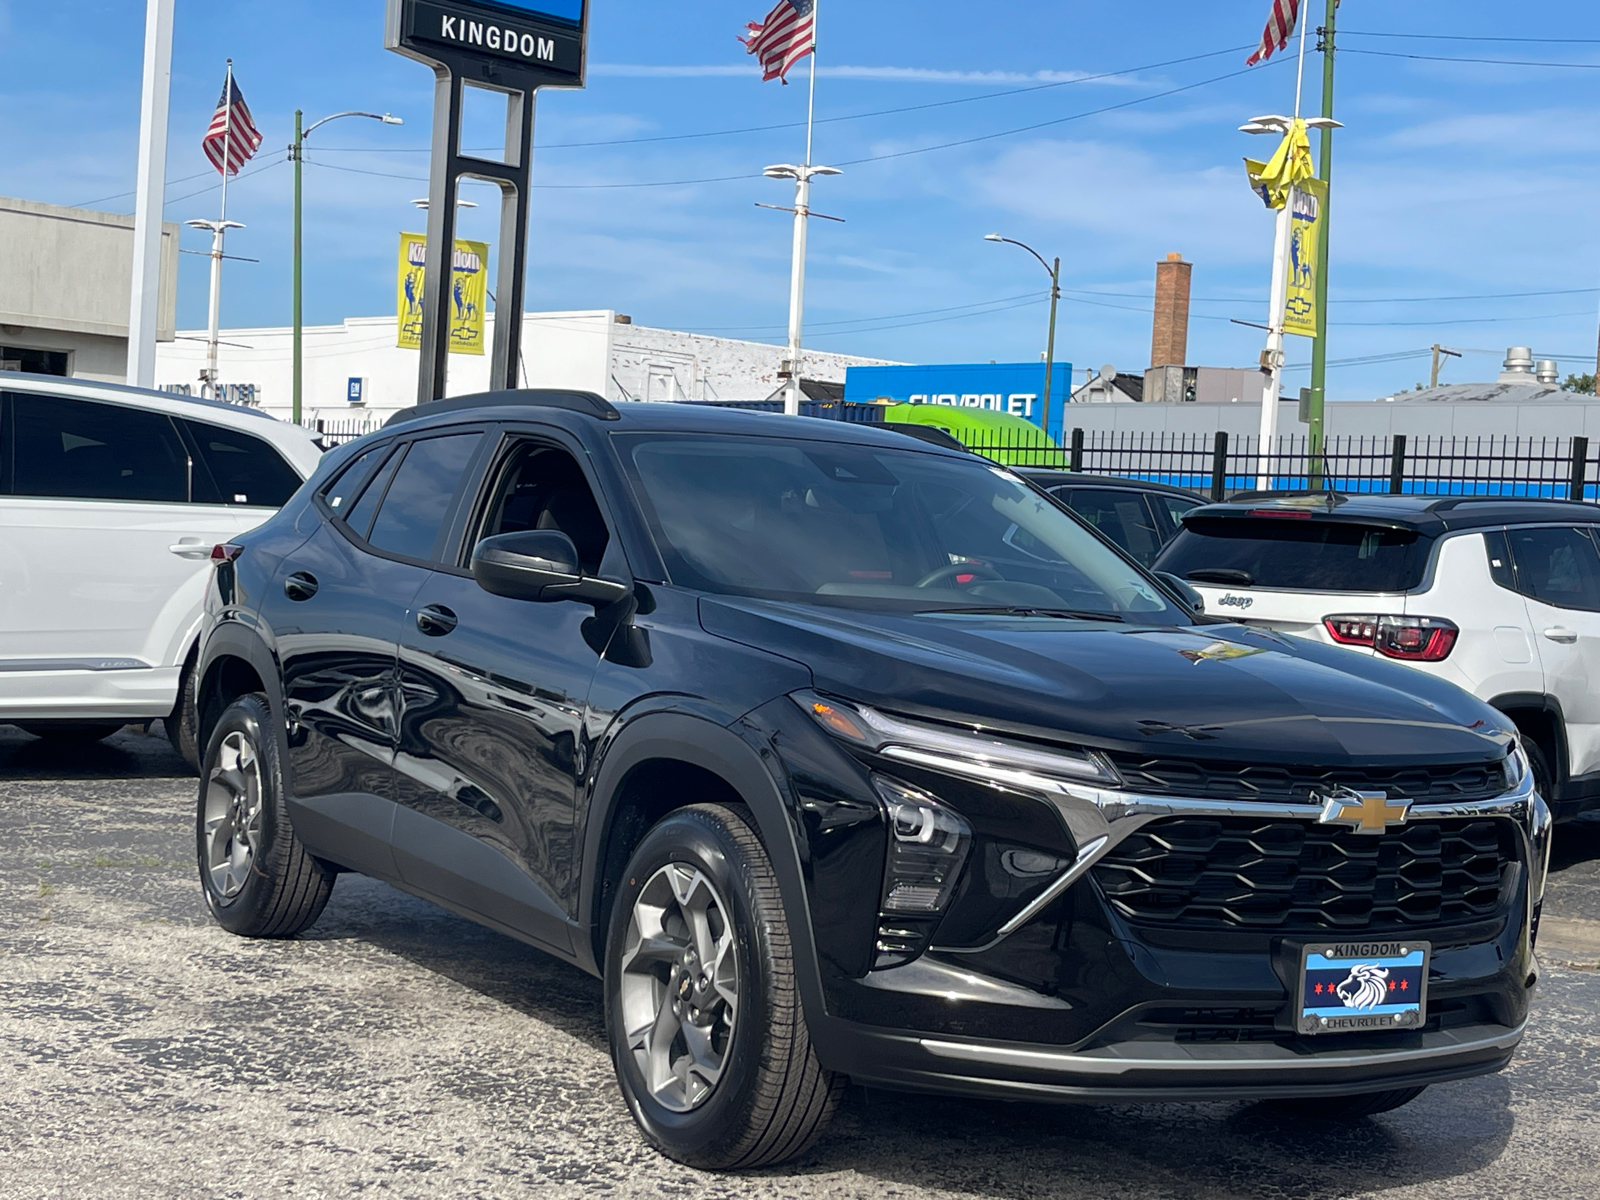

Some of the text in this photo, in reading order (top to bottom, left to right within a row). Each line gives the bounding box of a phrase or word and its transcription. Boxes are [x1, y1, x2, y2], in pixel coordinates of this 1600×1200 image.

[441, 15, 554, 61] KINGDOM
[408, 242, 427, 263] Kin
[1218, 593, 1253, 609] Jeep
[1334, 943, 1401, 957] KINGDOM
[1327, 1016, 1394, 1029] CHEVROLET
